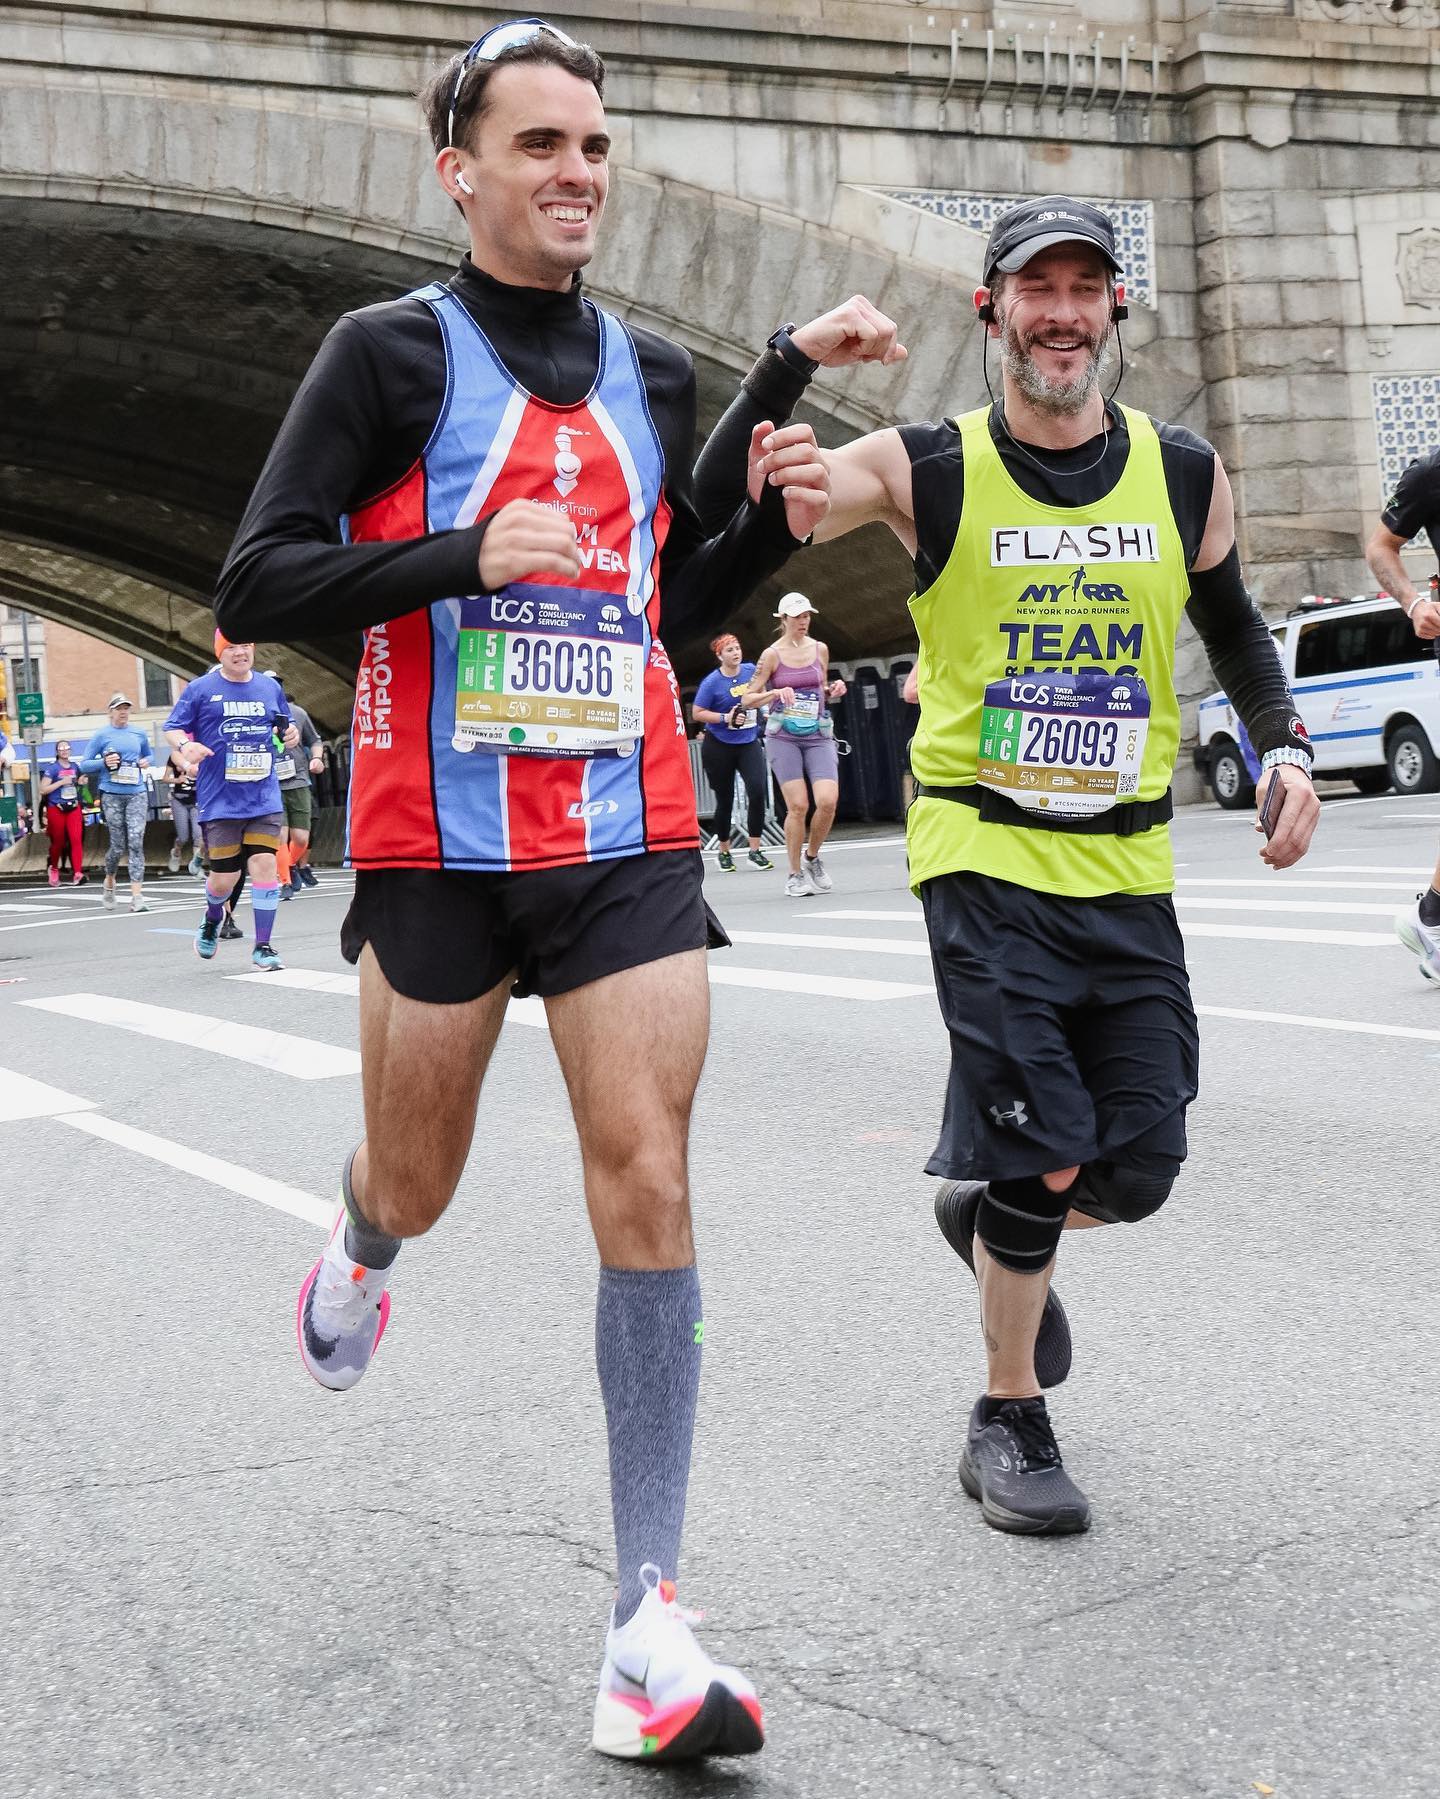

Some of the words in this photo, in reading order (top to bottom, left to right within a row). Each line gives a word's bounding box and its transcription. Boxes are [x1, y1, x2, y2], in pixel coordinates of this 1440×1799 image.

[995, 526, 1156, 562] FLASH!
[490, 594, 534, 624] tcs
[538, 610, 586, 621] CONSULTANCY
[539, 602, 560, 611] TATA
[1065, 607, 1089, 615] ROAD
[1091, 607, 1130, 615] RUNNERS
[538, 618, 569, 627] SERVICES
[597, 622, 624, 635] TATA
[485, 633, 497, 658] 5
[1000, 623, 1144, 661] TEAM
[484, 664, 496, 691] E
[511, 637, 613, 698] 36036
[623, 656, 633, 692] 2021
[370, 622, 393, 750] EMPOWE
[1010, 679, 1050, 705] tcs
[1054, 687, 1073, 695] TATA
[222, 701, 266, 716] JAMES
[358, 666, 374, 750] TEAM
[1052, 700, 1080, 708] SERVICES
[1053, 694, 1097, 703] CONSULTANCY
[1107, 702, 1132, 711] TATA
[586, 715, 616, 724] RUNNING
[1003, 712, 1014, 732] 4
[999, 739, 1012, 761] C
[1022, 716, 1119, 768] 26093
[1126, 728, 1137, 761] 2021
